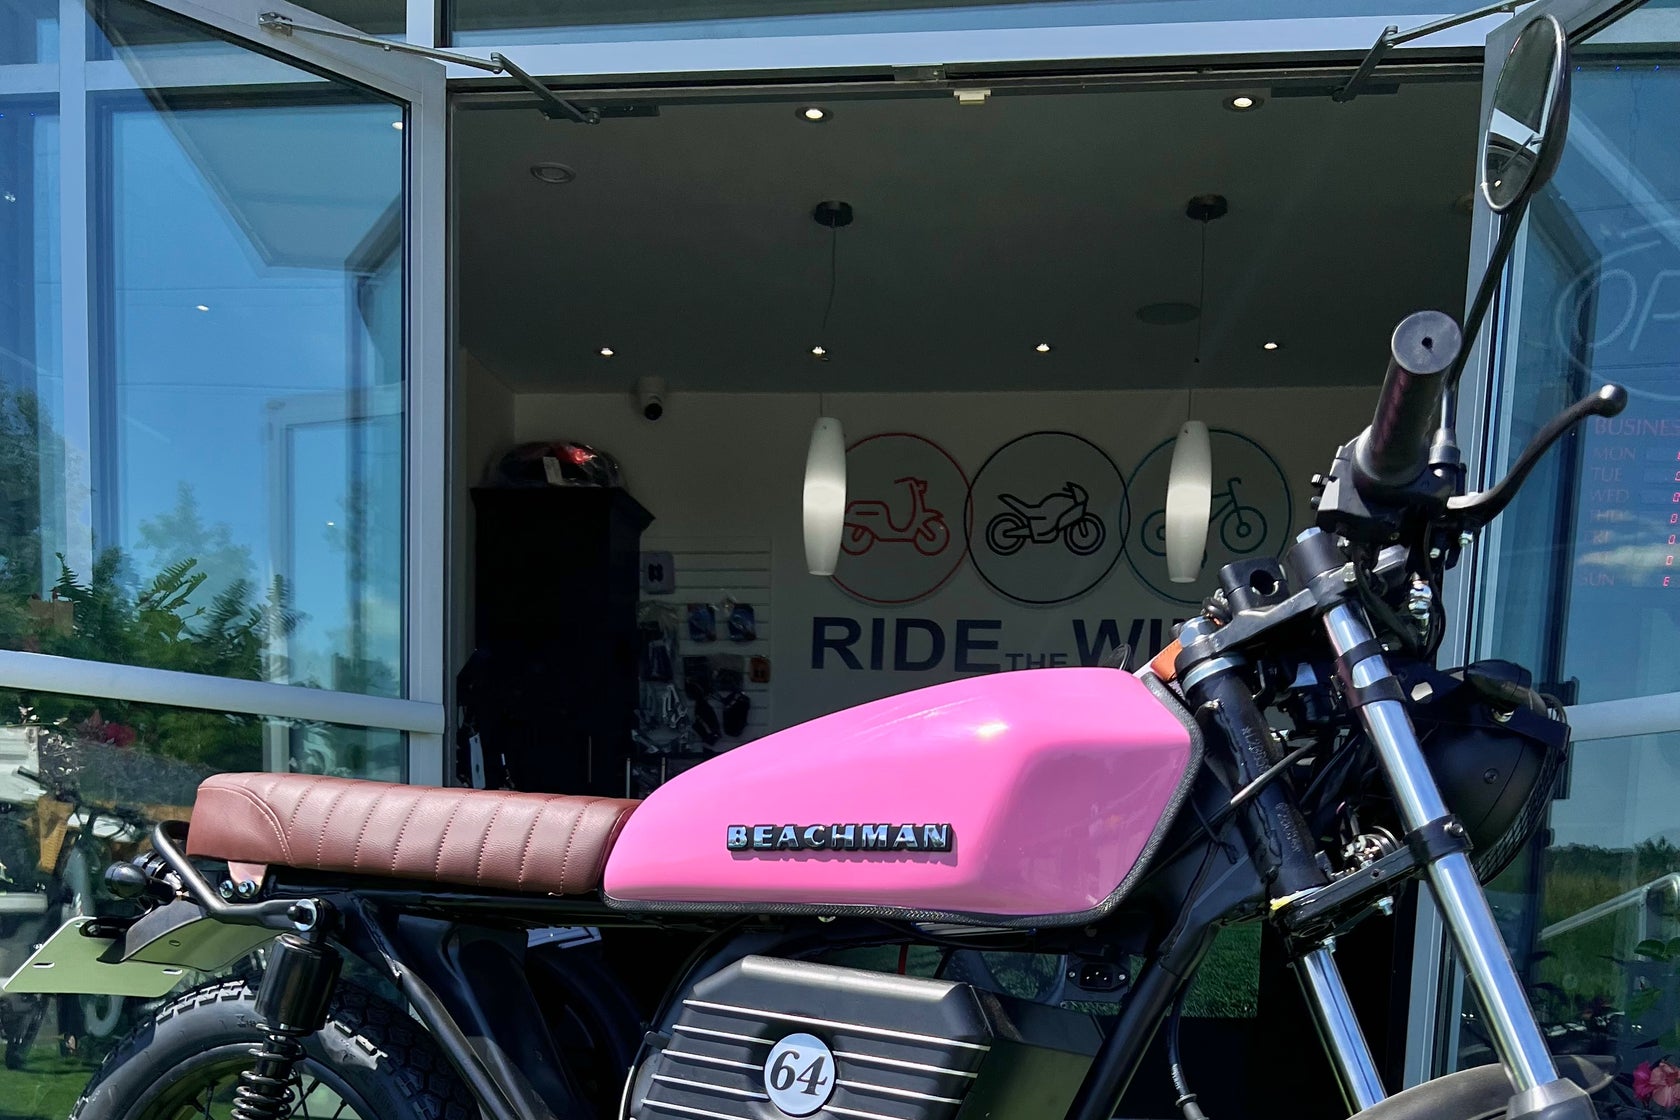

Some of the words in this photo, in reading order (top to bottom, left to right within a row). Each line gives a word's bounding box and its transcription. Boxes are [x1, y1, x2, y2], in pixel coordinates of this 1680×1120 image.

[1591, 467, 1624, 482] TUE
[811, 616, 1002, 673] RIDE
[1005, 653, 1068, 671] THE
[1072, 618, 1186, 675] WI
[727, 823, 951, 850] BEACHMAN
[770, 1050, 828, 1096] 64
